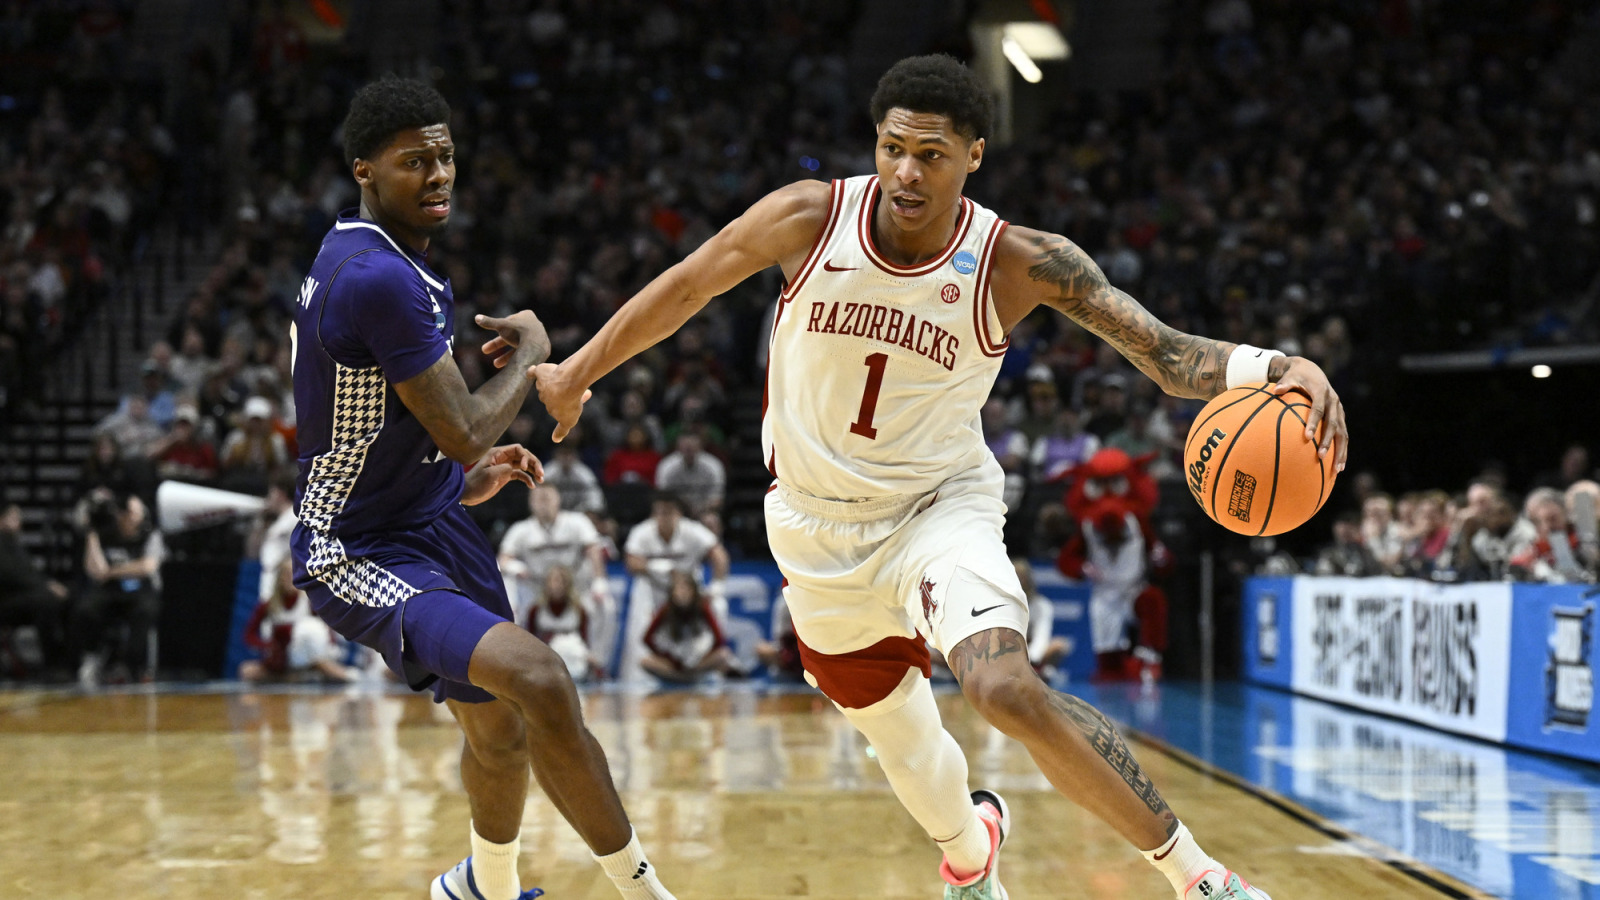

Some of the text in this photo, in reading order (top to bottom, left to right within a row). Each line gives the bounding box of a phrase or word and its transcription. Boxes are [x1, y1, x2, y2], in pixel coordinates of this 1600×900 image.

[956, 260, 975, 270] NCAA
[943, 285, 959, 302] SEC
[806, 301, 960, 372] RAZORBACKS
[850, 352, 889, 440] 1
[1229, 484, 1242, 510] MARCH
[1238, 474, 1255, 511] MADNESS
